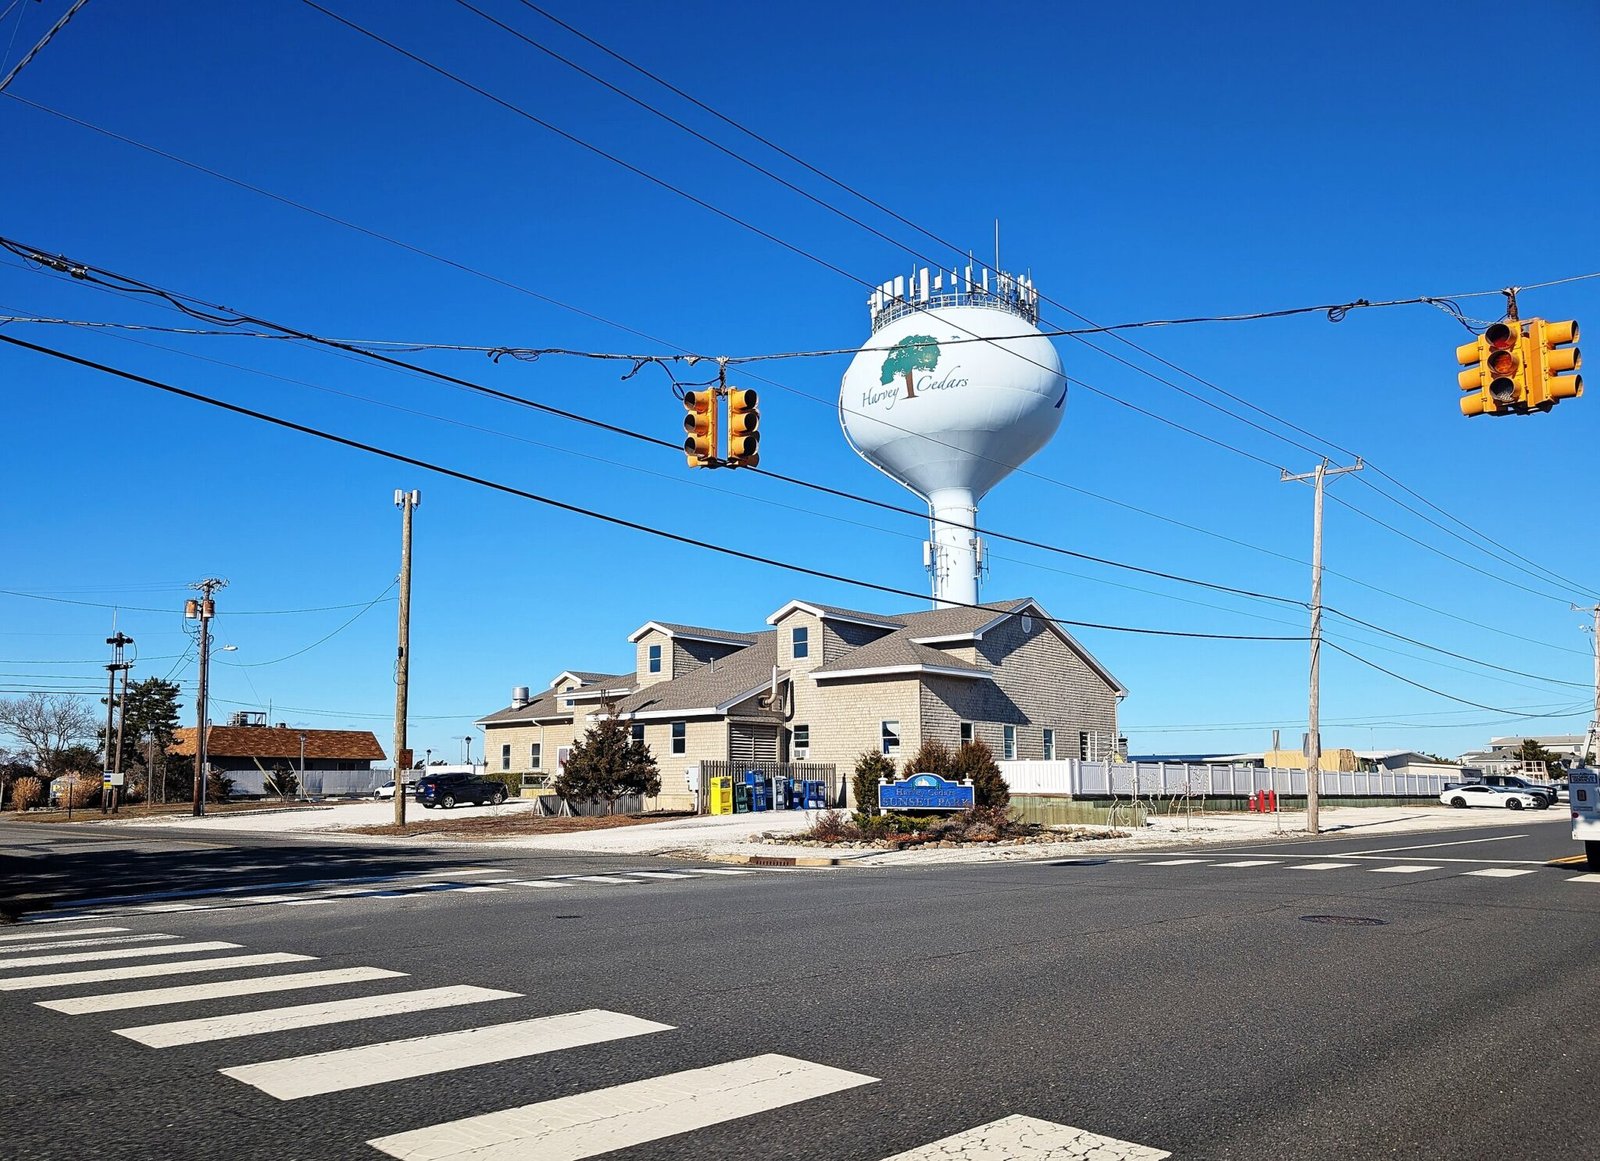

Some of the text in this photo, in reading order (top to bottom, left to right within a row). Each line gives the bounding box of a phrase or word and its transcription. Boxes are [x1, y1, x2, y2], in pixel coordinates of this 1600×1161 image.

[862, 365, 969, 410] Harvey Cedars
[896, 788, 924, 797] Harvey
[882, 797, 932, 806] SUNSET
